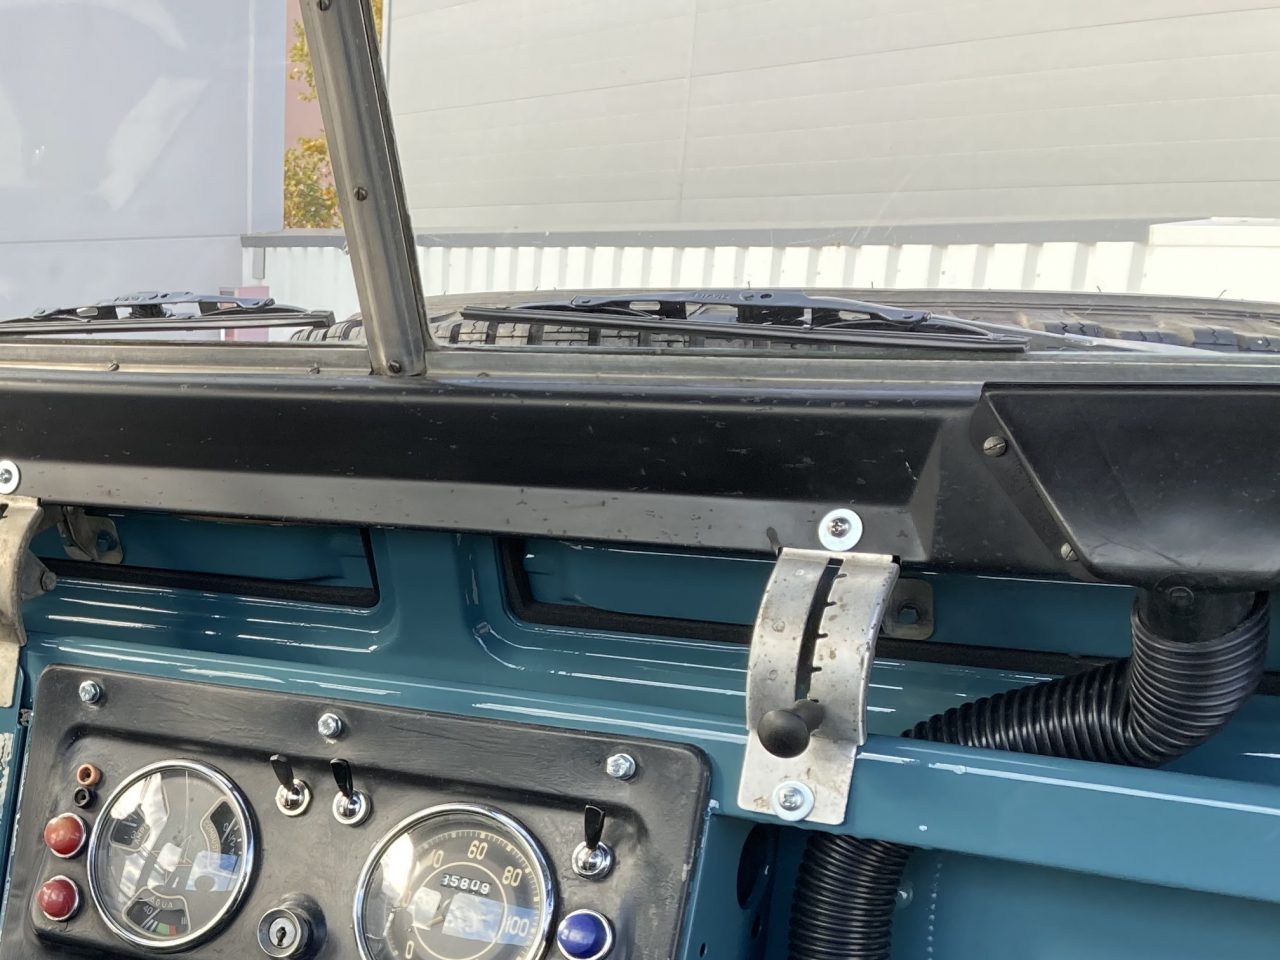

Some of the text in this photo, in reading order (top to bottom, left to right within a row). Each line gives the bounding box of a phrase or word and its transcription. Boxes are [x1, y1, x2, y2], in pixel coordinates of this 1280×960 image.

[467, 840, 488, 860] 60
[502, 866, 522, 887] 80
[505, 915, 530, 937] 100
[405, 940, 414, 959] 0
